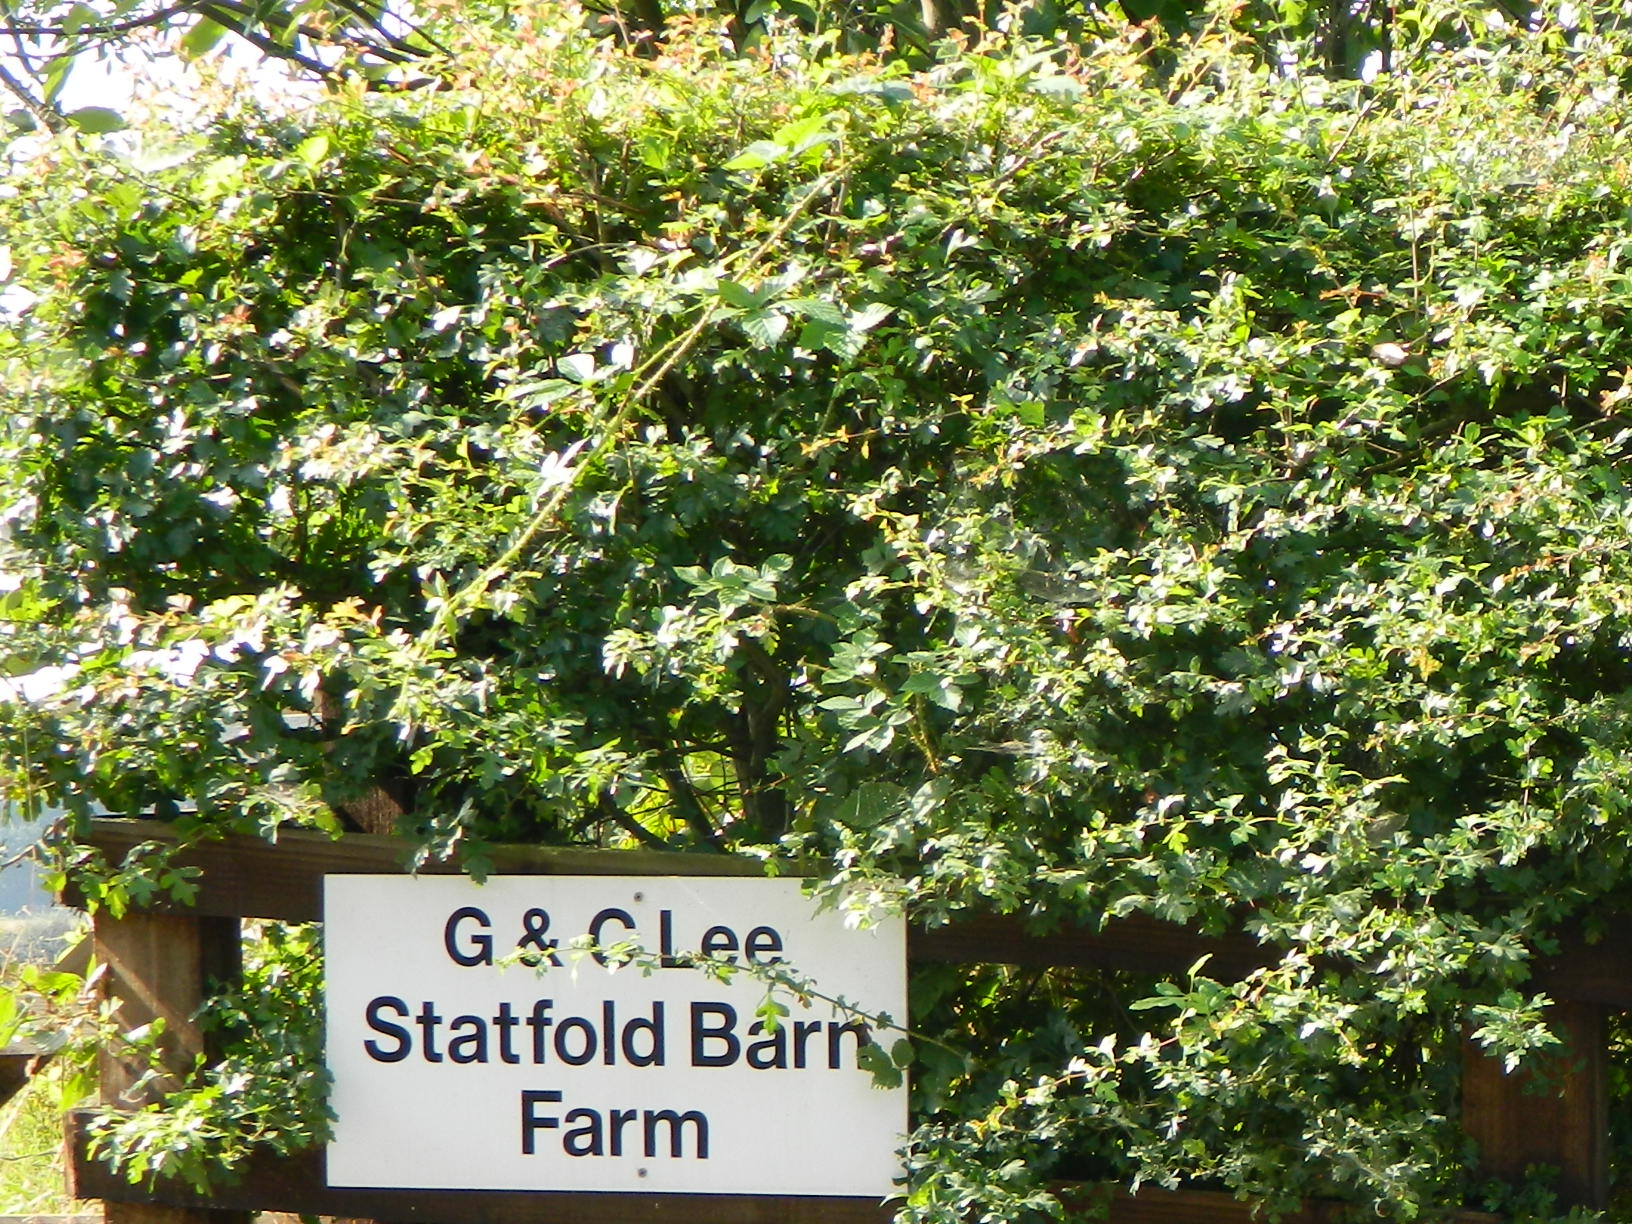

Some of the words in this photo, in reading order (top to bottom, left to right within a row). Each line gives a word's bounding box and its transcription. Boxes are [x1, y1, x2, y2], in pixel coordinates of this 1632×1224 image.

[444, 906, 494, 968] G
[516, 907, 565, 968] &
[588, 907, 636, 969] C
[660, 909, 785, 970] Lee
[363, 995, 665, 1068] Statfold
[690, 1001, 871, 1070] Barn
[521, 1089, 709, 1160] Farm
